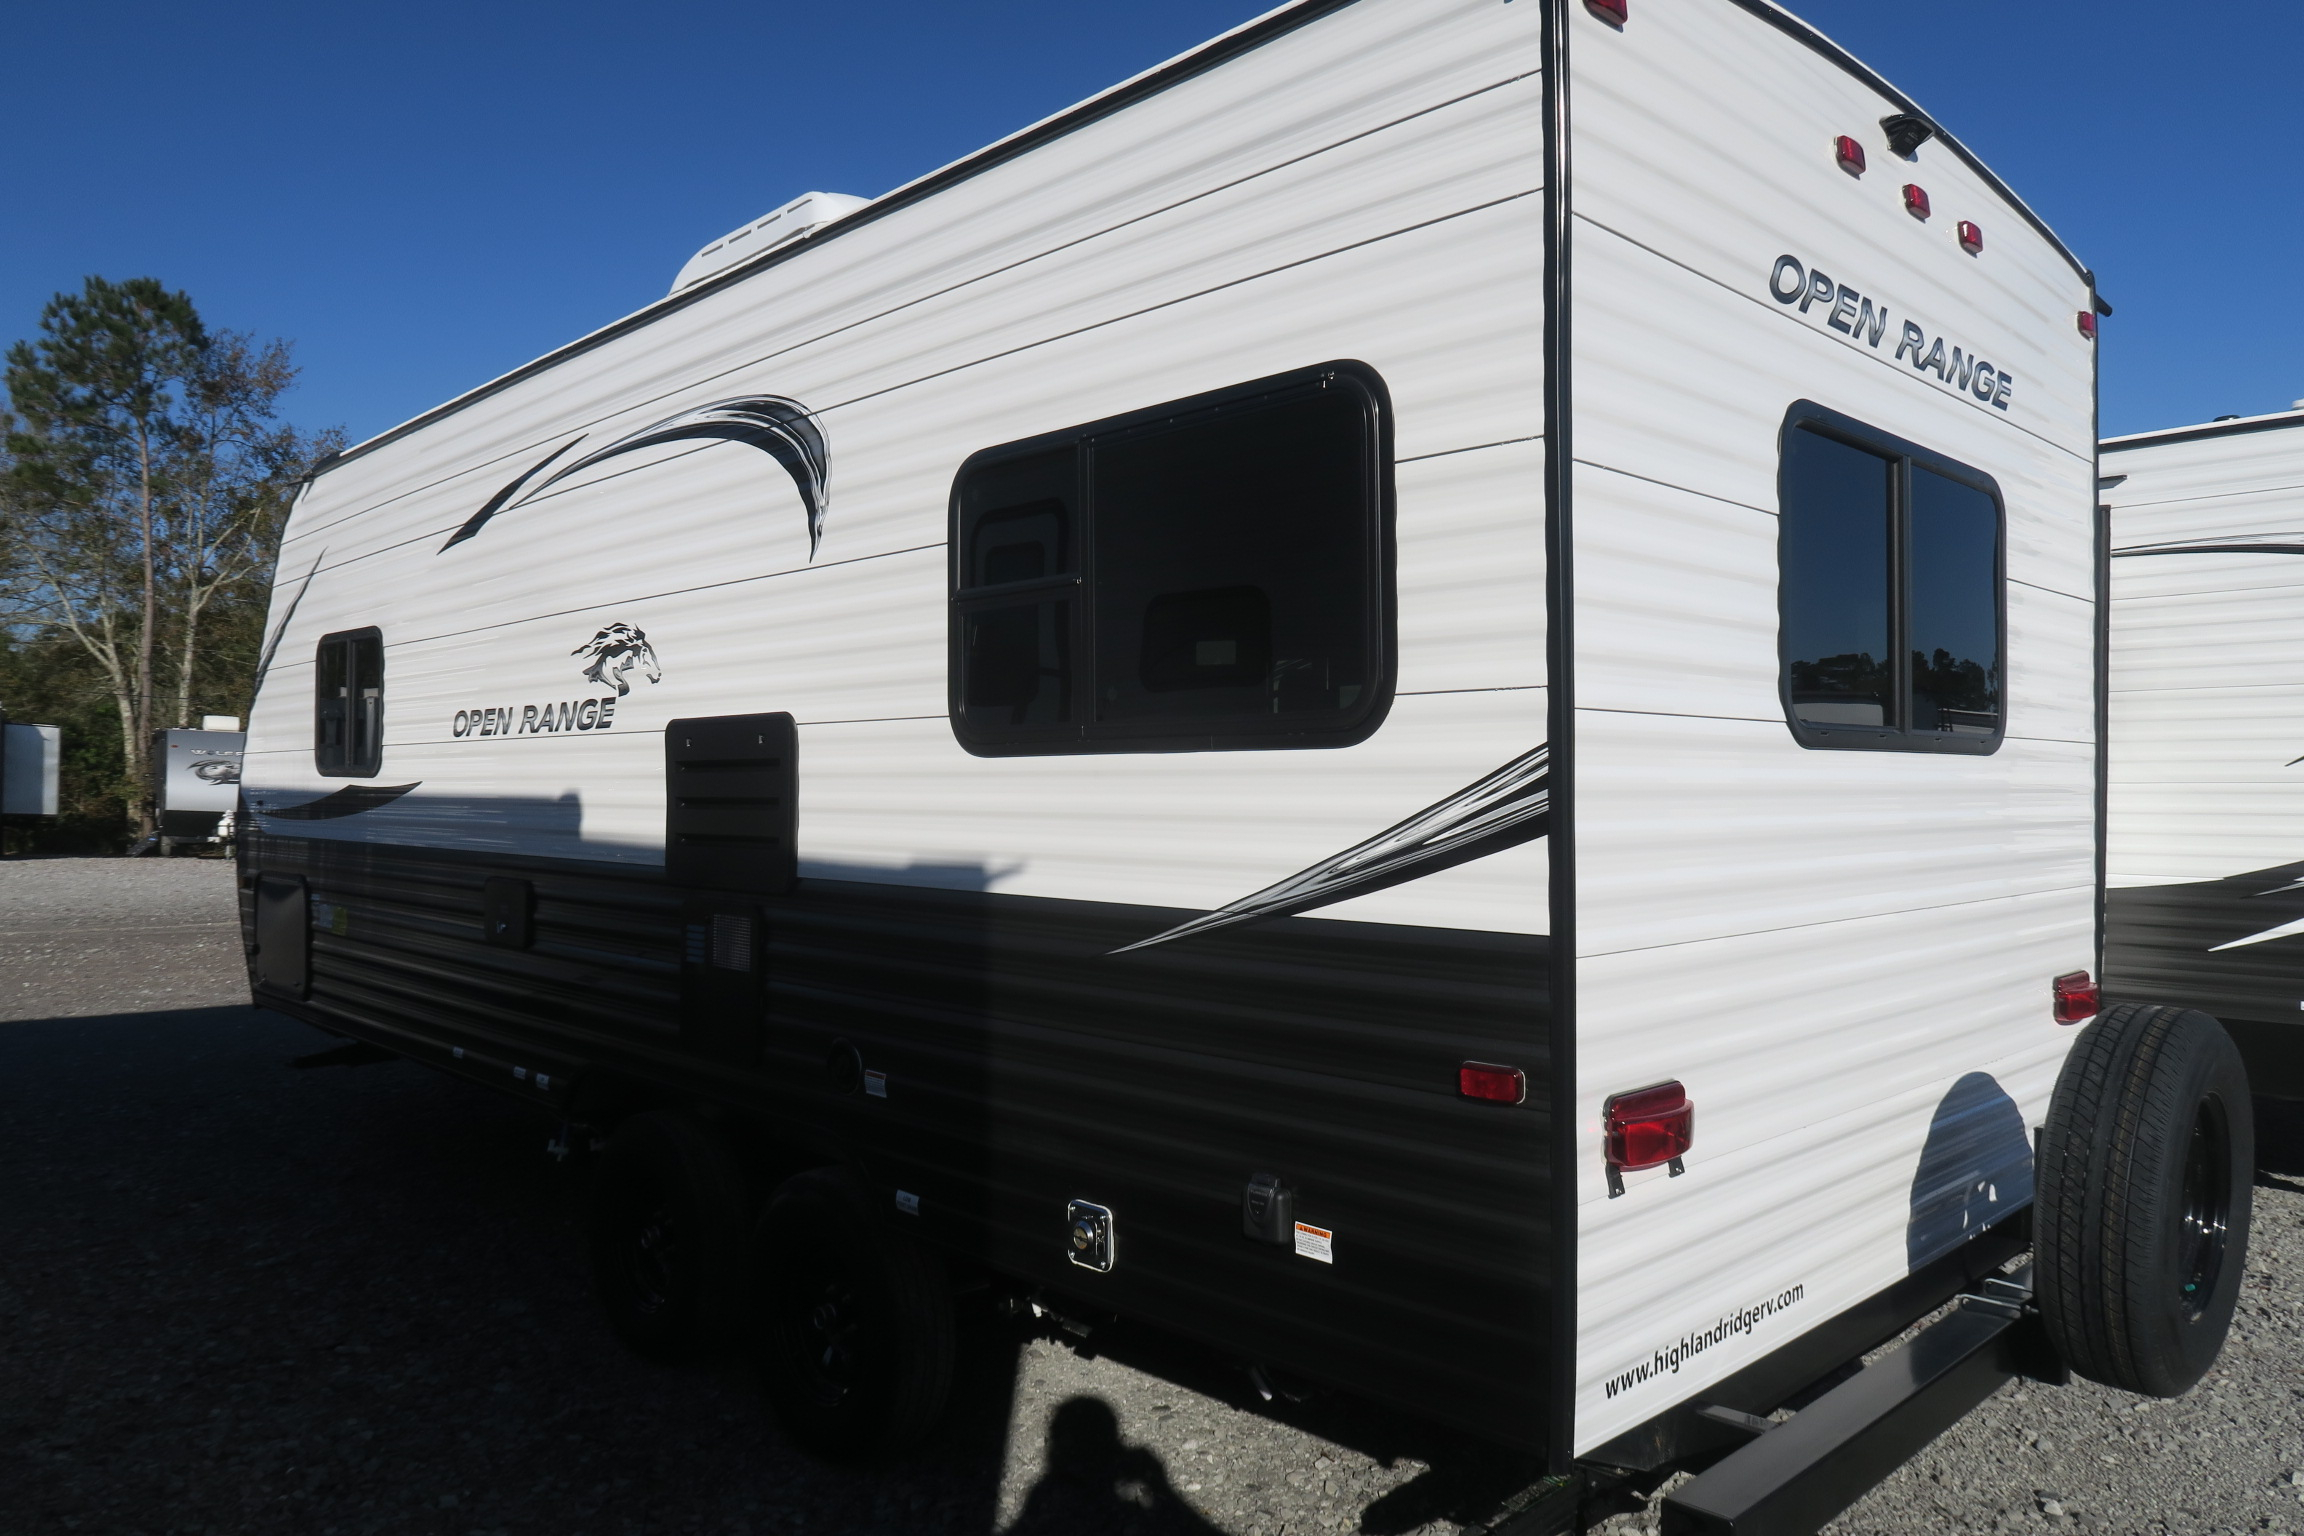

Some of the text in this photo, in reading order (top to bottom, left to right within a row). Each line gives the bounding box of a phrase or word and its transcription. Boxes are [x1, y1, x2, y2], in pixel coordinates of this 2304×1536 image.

[1769, 254, 2013, 412] OPEN RANGE
[453, 696, 617, 738] OPEN RANGE
[1605, 1283, 1804, 1400] www.highlandridgerv.com
